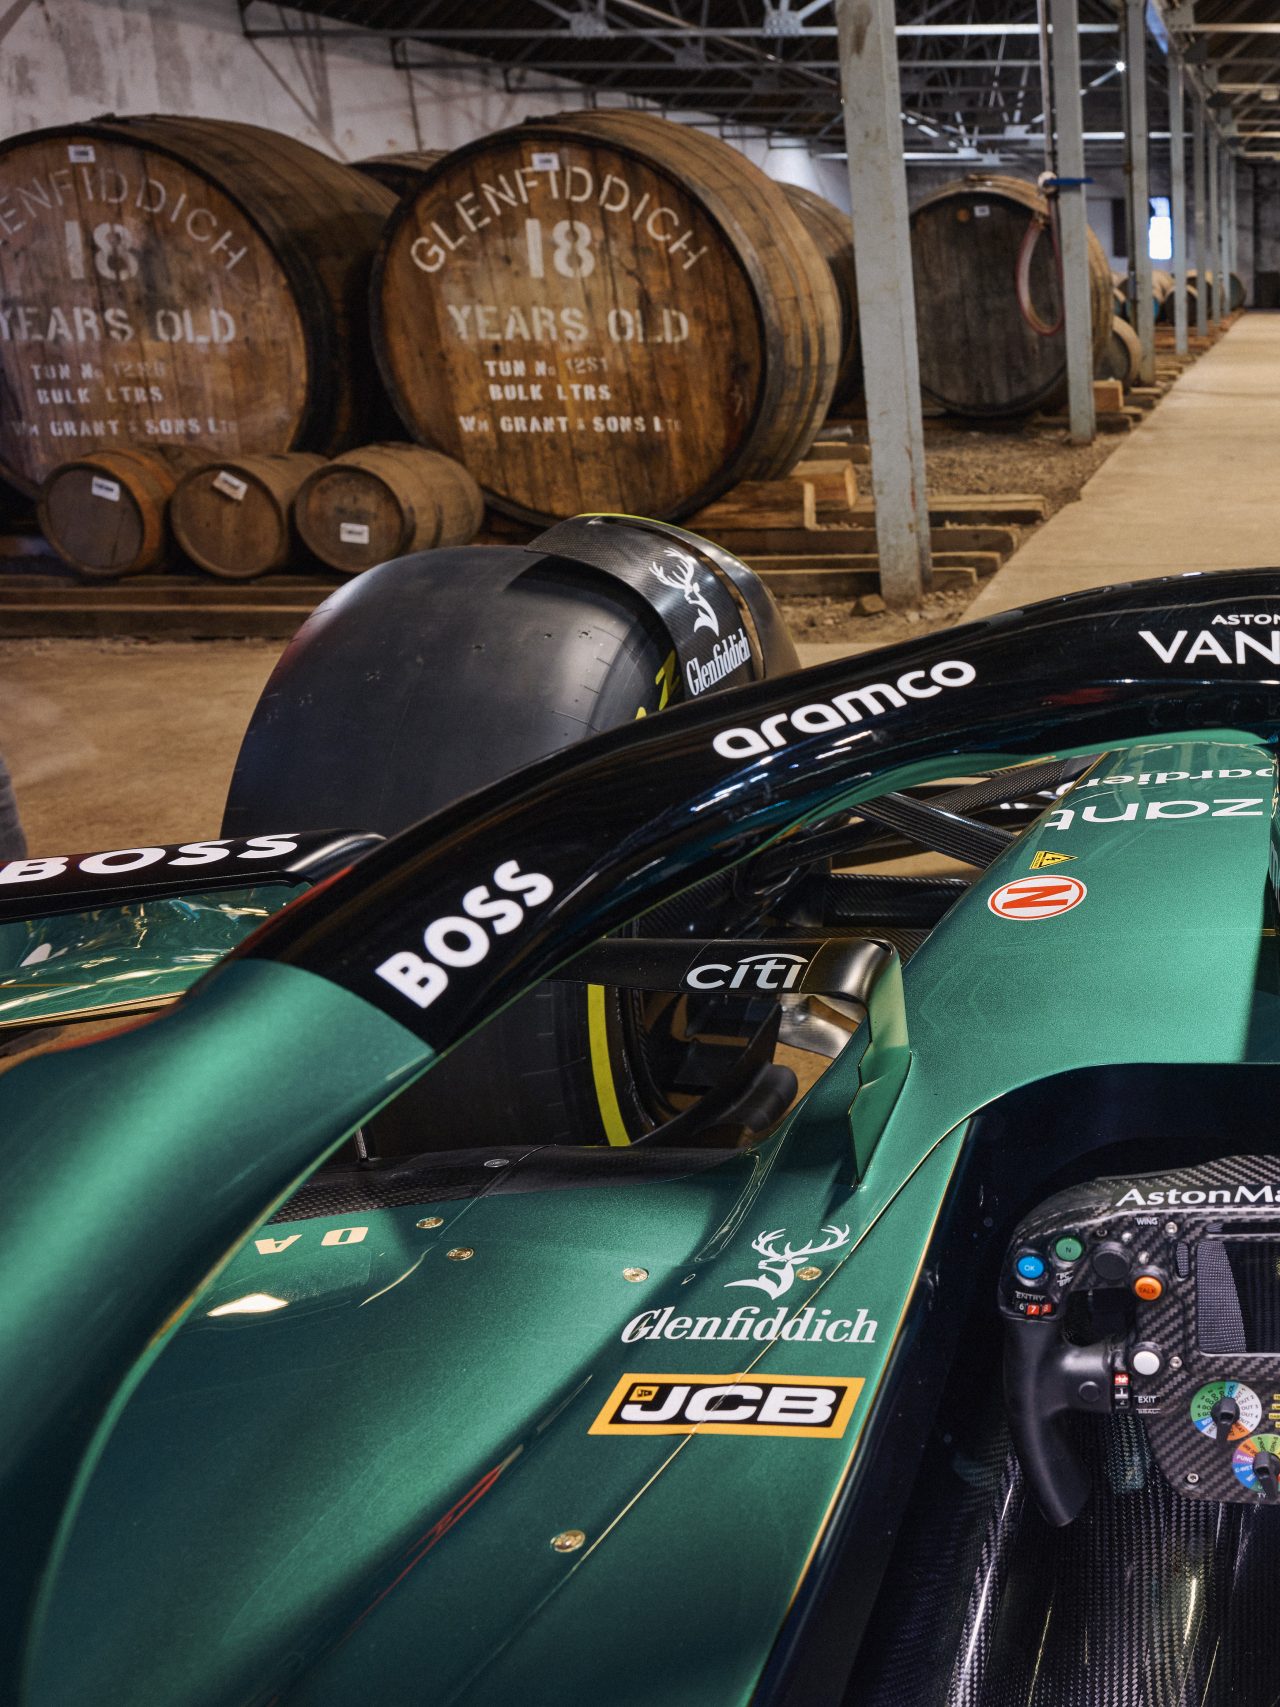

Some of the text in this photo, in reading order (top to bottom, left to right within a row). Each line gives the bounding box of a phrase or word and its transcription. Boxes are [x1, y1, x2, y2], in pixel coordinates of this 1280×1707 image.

[0, 167, 248, 270] ENFIDDICH
[410, 165, 709, 273] GLENFIDDICH
[64, 220, 140, 281] 18
[524, 218, 596, 279] 18
[0, 306, 237, 343] YEARS OLD
[447, 304, 690, 344] YEARS OLD
[31, 364, 70, 381] TUN
[483, 360, 526, 377] TUN
[36, 386, 164, 405] BULK LTRS
[488, 383, 612, 401] BULK LTRS
[50, 419, 120, 437] GRANT
[146, 416, 200, 435] SONS
[500, 415, 569, 433] GRANT
[592, 415, 646, 433] SONS
[686, 627, 752, 696] Glenfiddich
[712, 660, 977, 760] aramco
[0, 832, 301, 885] BOSS
[375, 859, 555, 1010] BOSS
[686, 952, 809, 991] citi
[1136, 1217, 1158, 1226] WING
[620, 1306, 879, 1345] Glenfiddich
[620, 1384, 838, 1424] JCB
[1138, 1395, 1157, 1404] EXIT
[1236, 1454, 1254, 1463] PUNC
